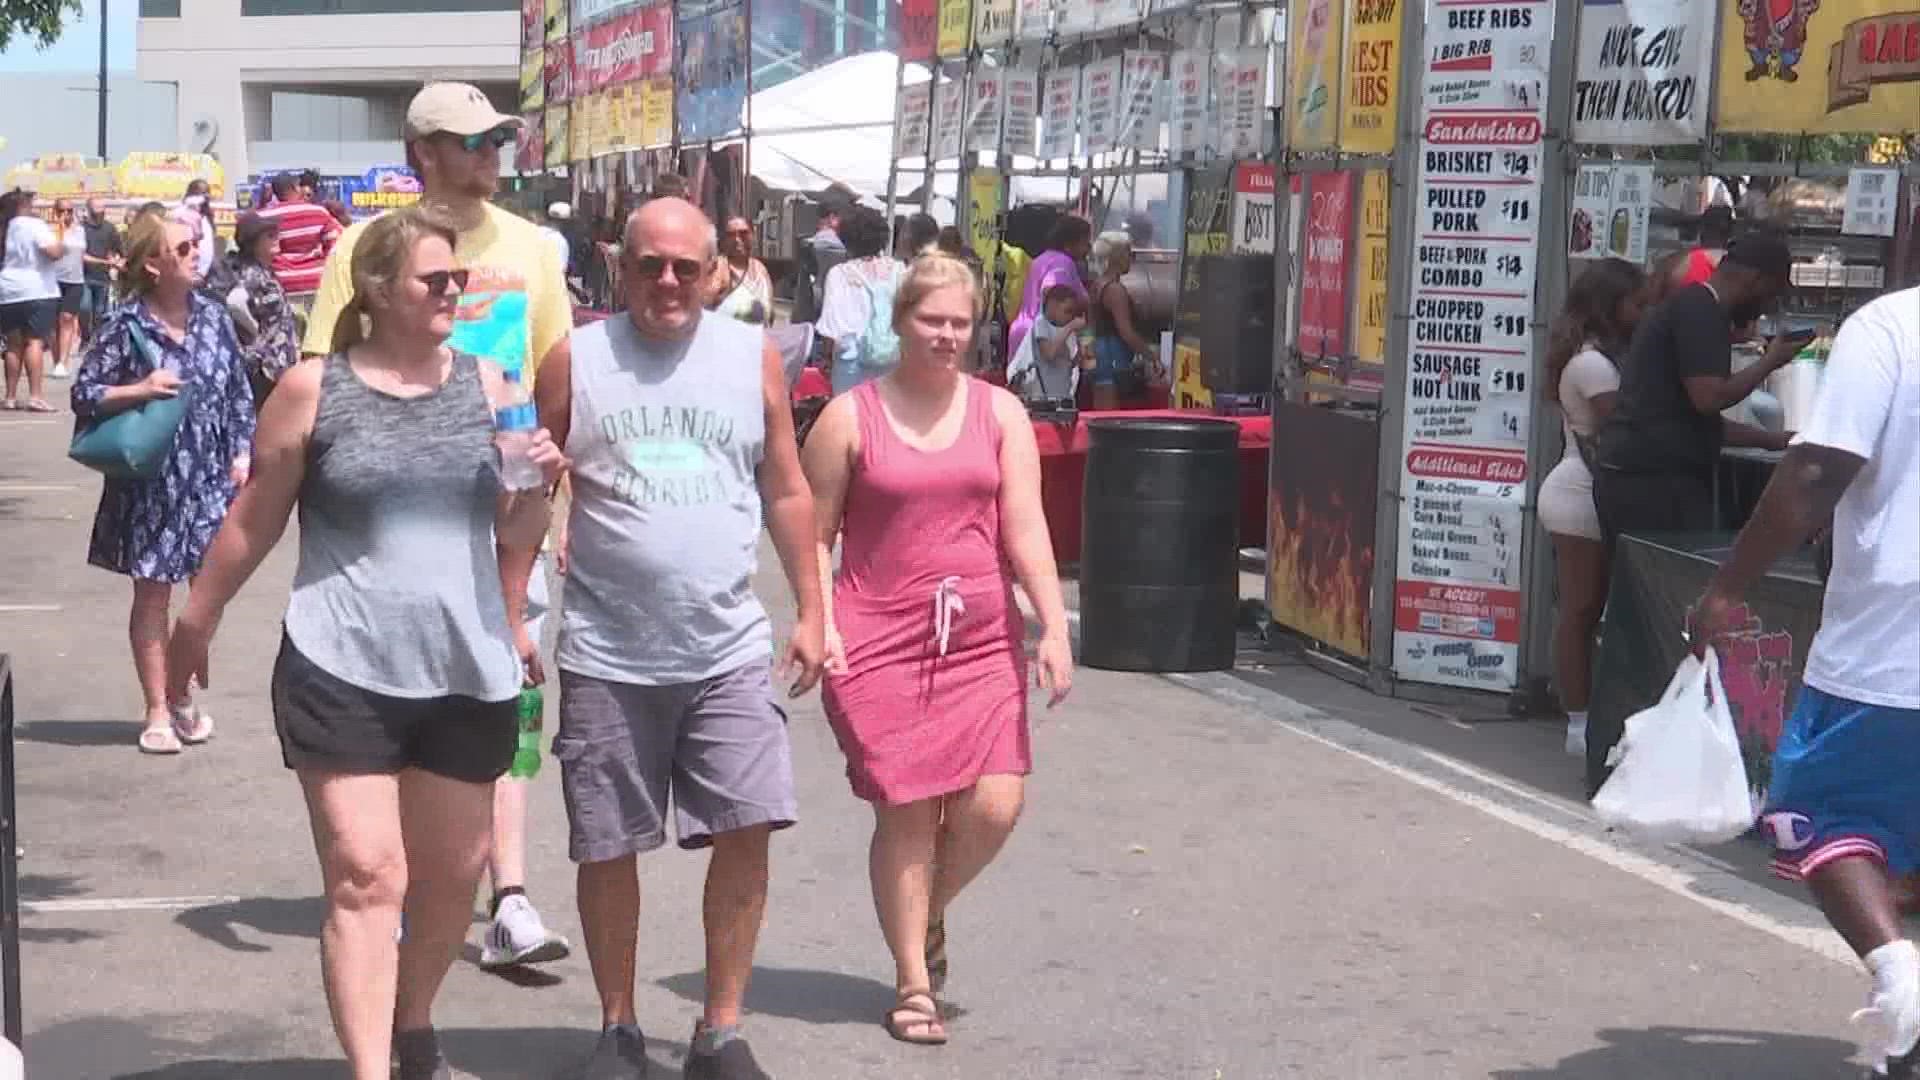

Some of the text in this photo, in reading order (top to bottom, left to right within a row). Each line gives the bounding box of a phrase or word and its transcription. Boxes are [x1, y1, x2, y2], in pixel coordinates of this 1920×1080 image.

[1448, 8, 1532, 29] BEEF RIBS
[1441, 44, 1463, 60] BIG
[1468, 39, 1492, 56] RIB
[1429, 119, 1537, 141] Sandwiches
[1426, 151, 1493, 173] BRISKET
[1427, 188, 1486, 209] PULLED
[1432, 212, 1479, 232] PORK
[1421, 267, 1483, 288] COMBO
[1416, 298, 1485, 321] CHOPPED
[1416, 321, 1483, 344] CHICKEN
[1413, 353, 1481, 377] SAUSAGE
[1413, 378, 1481, 402] HOT LINK
[602, 406, 734, 447] ORLANDO
